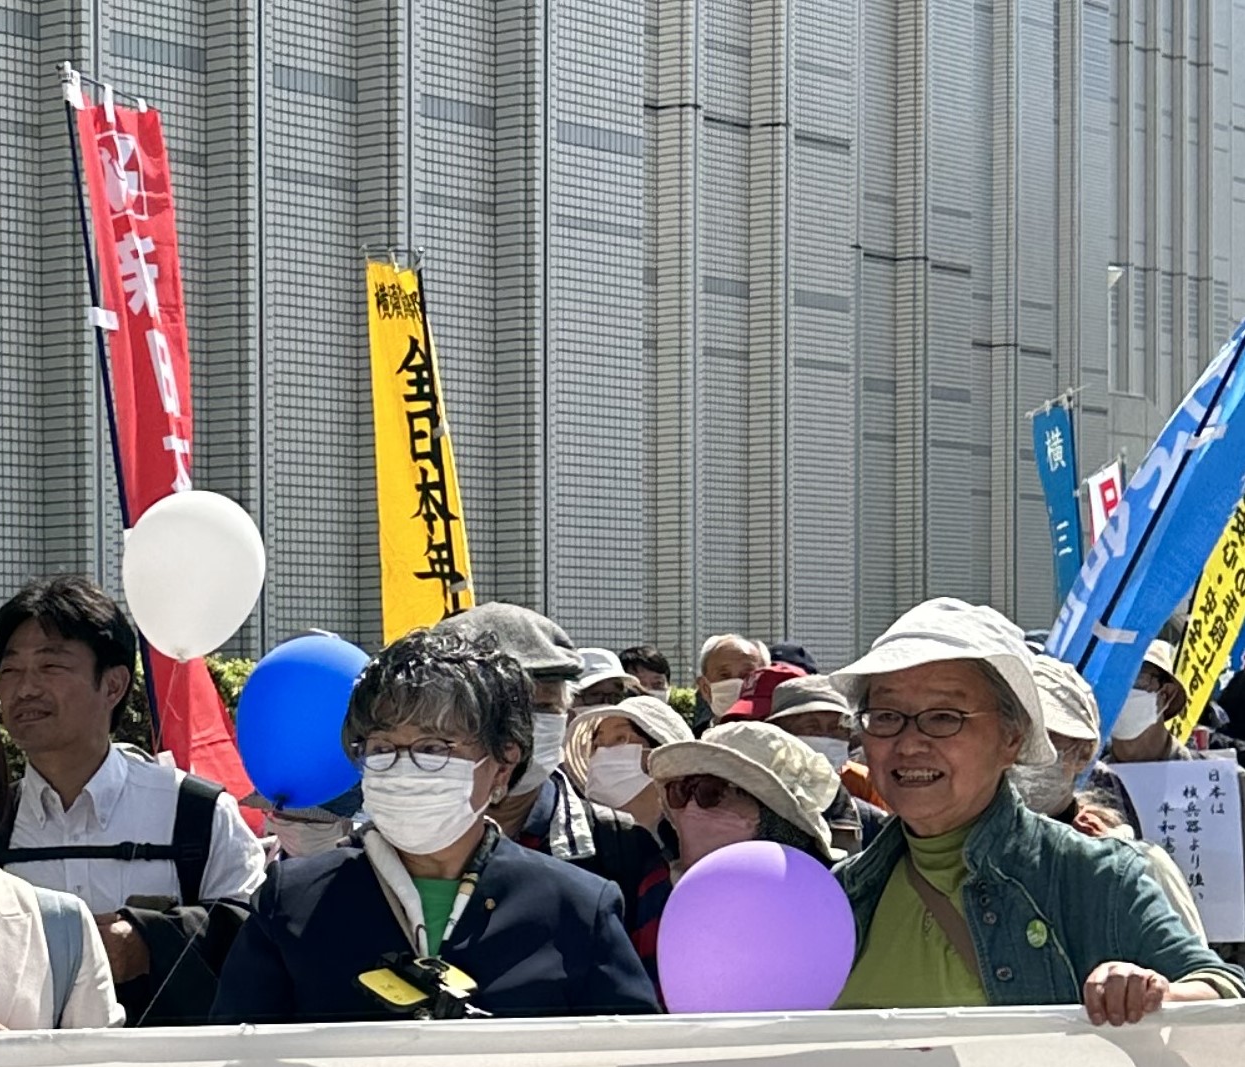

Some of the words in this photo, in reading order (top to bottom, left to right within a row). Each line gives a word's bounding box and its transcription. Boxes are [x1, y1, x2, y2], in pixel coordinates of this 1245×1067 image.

[395, 335, 466, 620] 全日本年
[1208, 769, 1227, 815] 日本は
